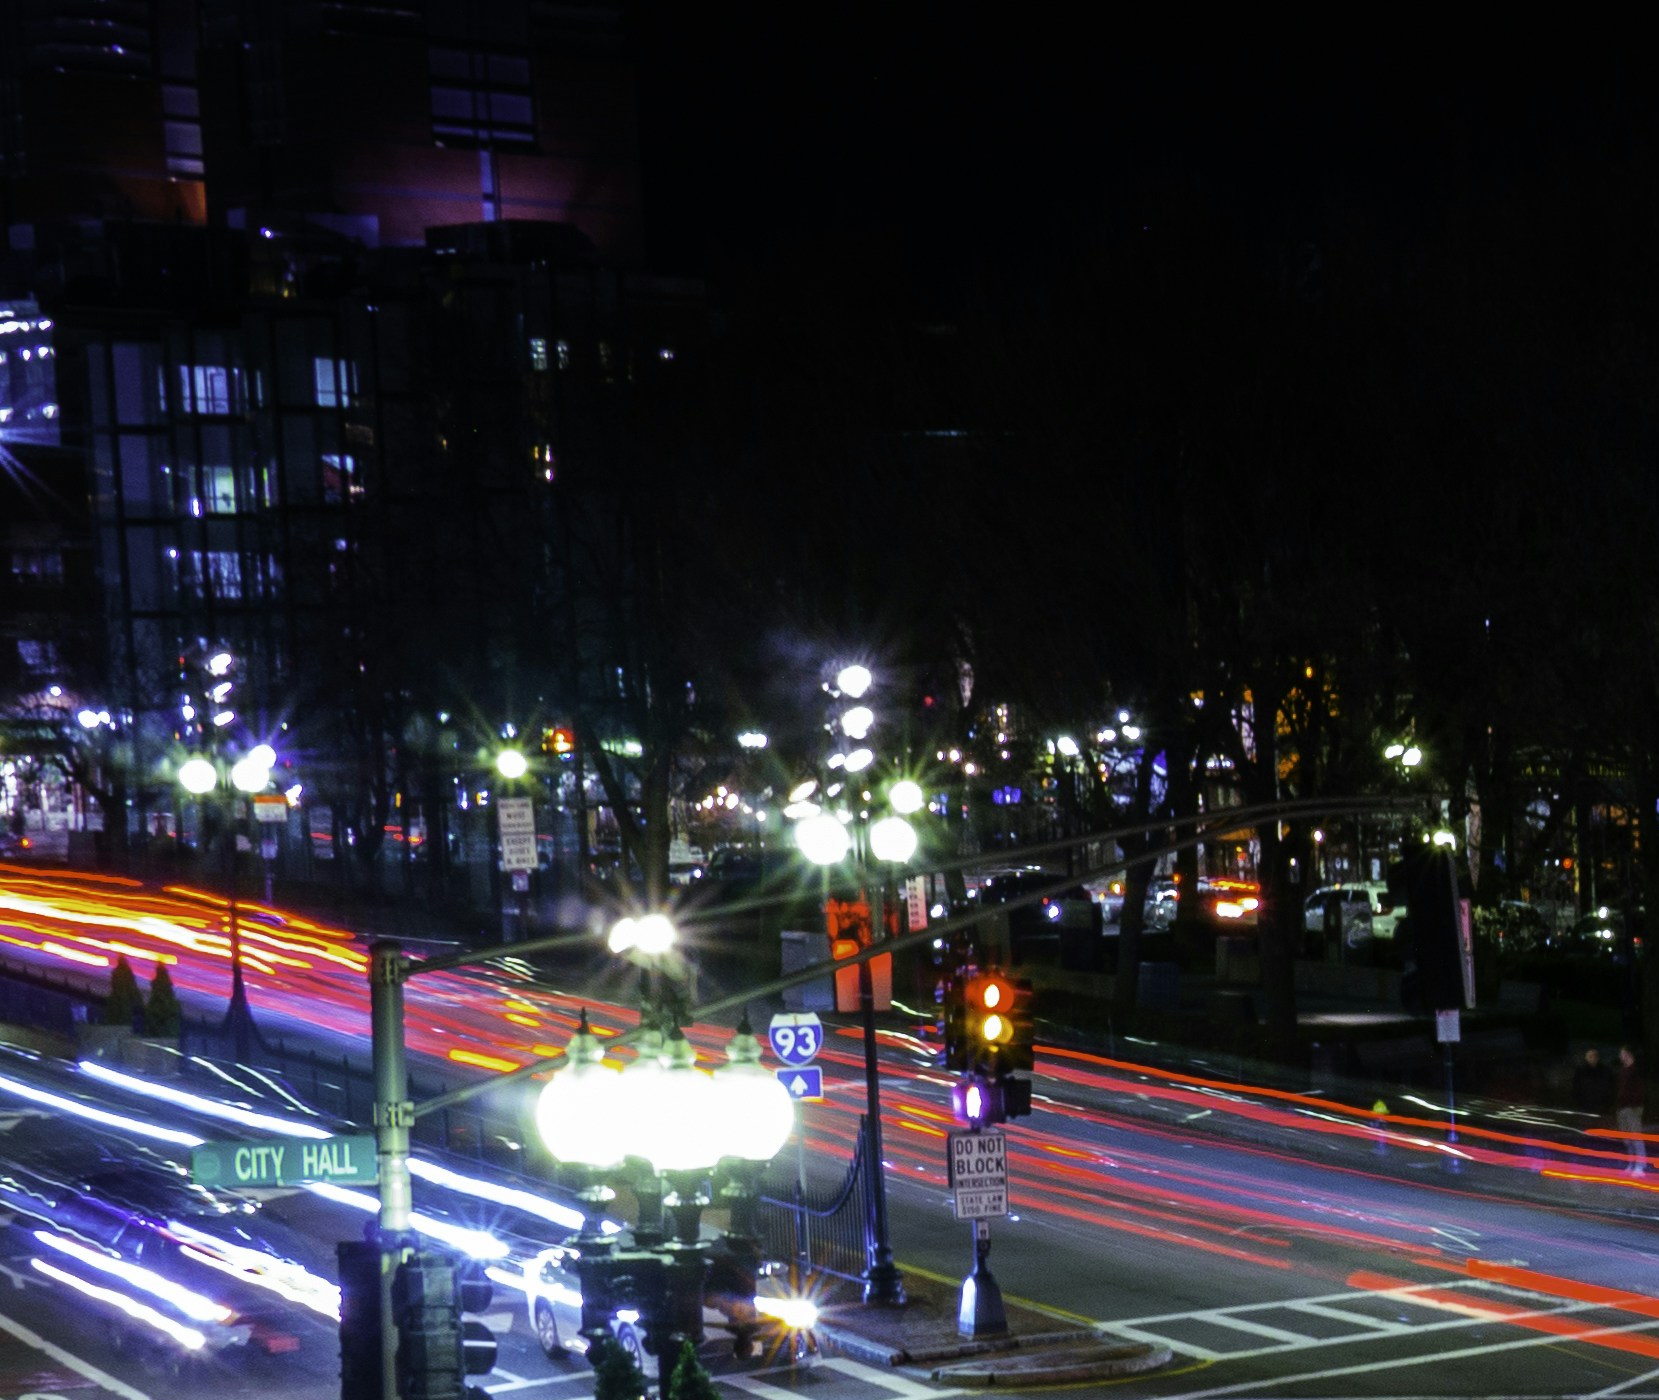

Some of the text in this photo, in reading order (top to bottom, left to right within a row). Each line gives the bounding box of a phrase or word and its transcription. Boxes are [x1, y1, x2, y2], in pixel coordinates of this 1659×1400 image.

[775, 1027, 816, 1057] 93
[956, 1138, 1003, 1155] DO NOT
[235, 1143, 357, 1181] CITY HALL
[957, 1157, 1004, 1174] BLOCK
